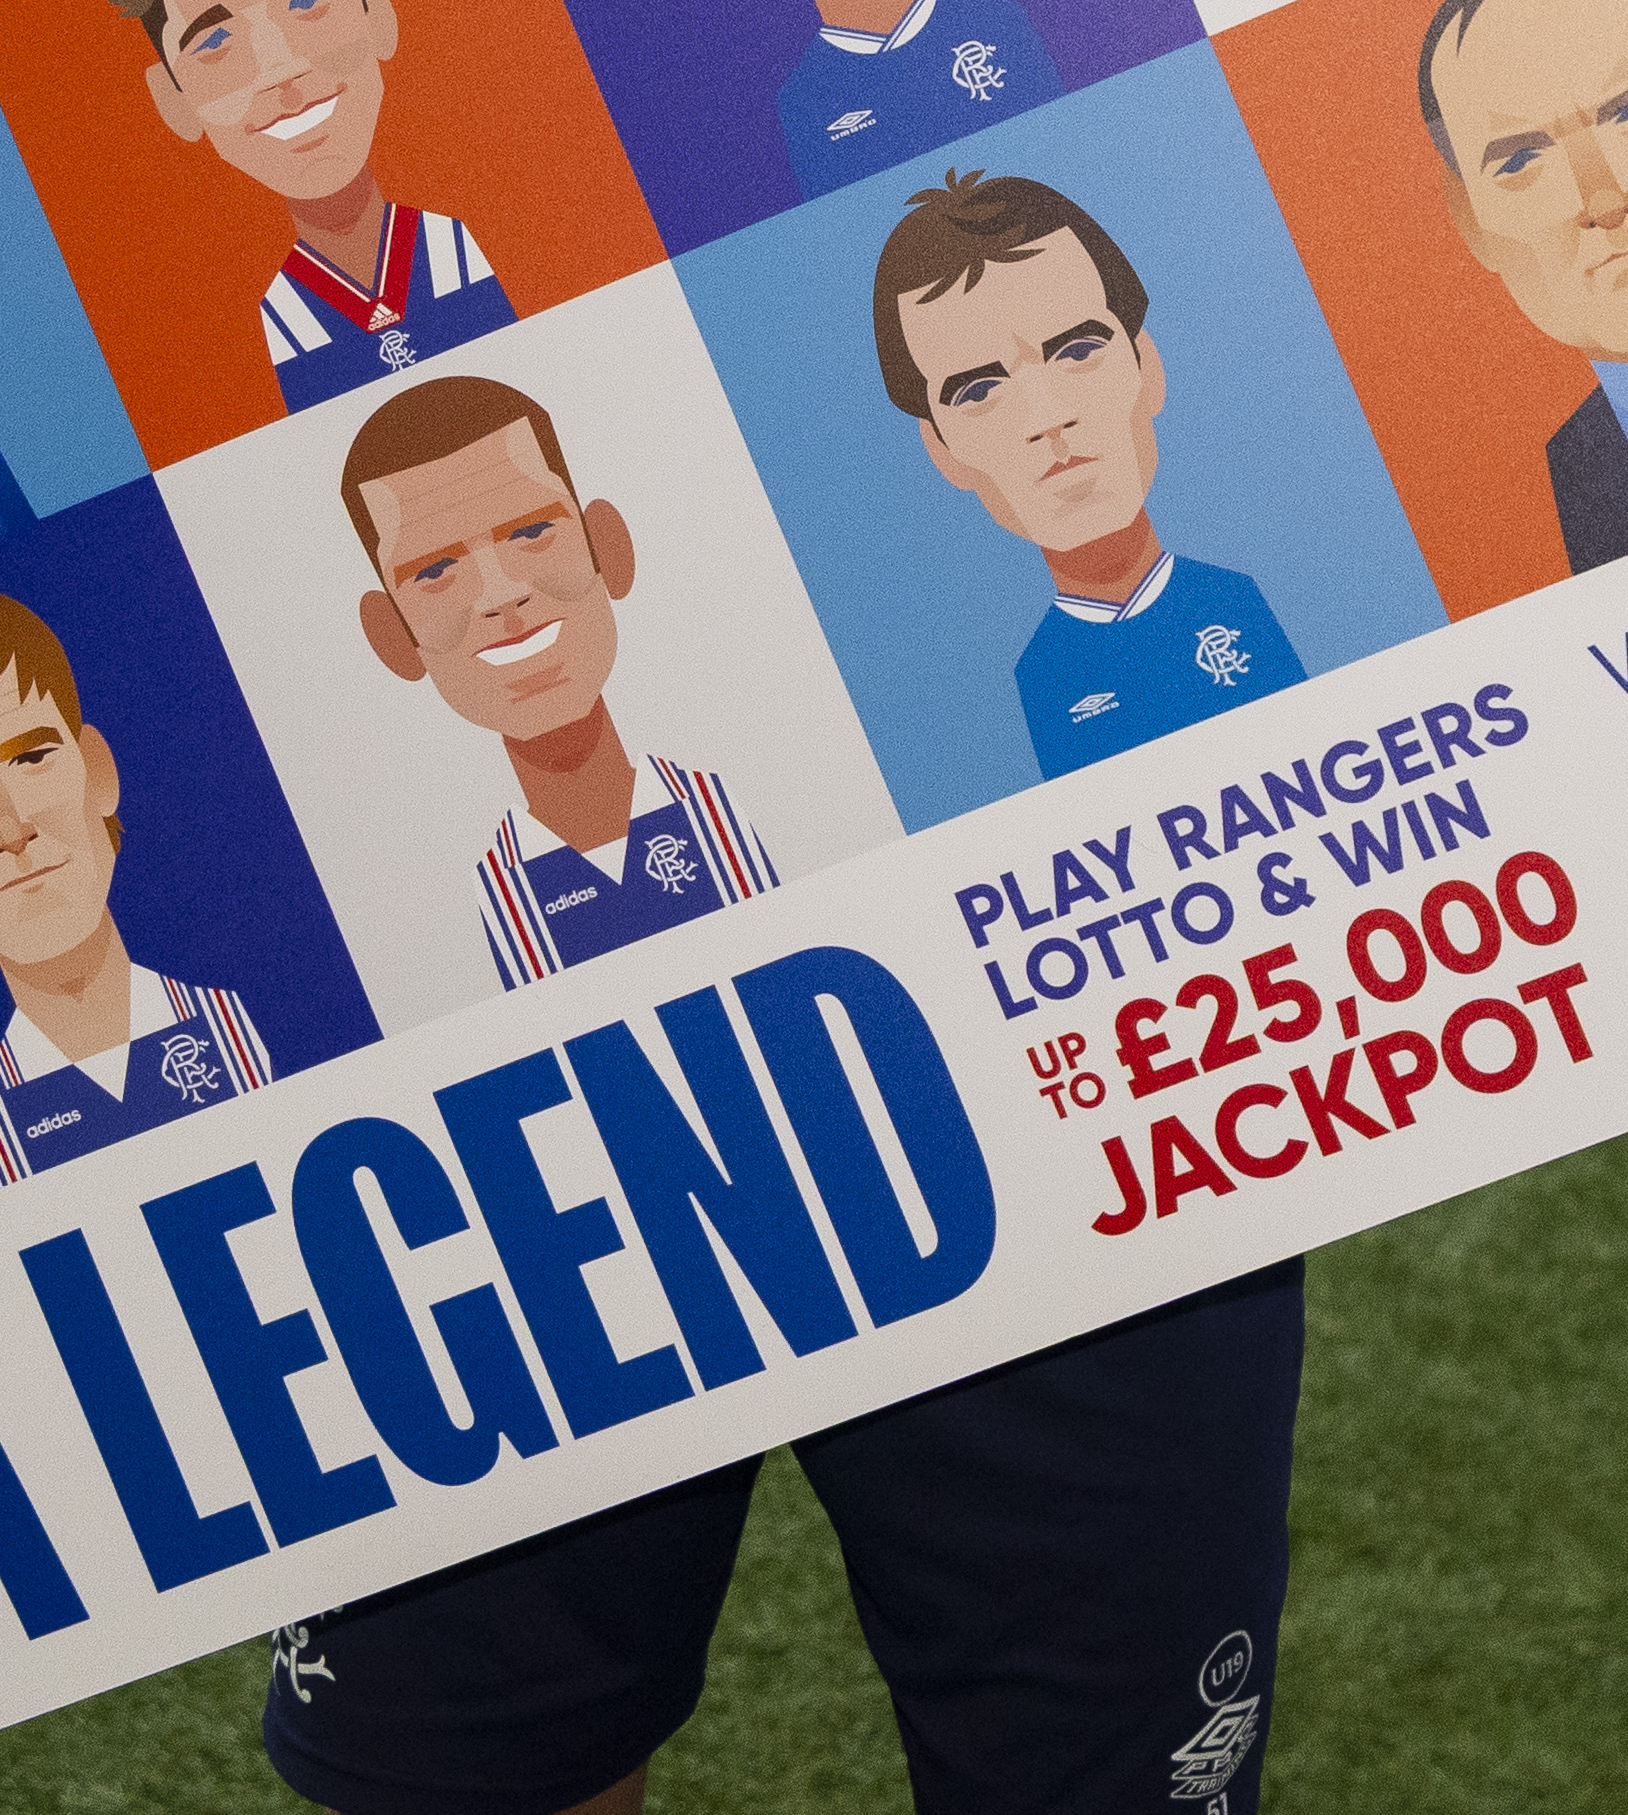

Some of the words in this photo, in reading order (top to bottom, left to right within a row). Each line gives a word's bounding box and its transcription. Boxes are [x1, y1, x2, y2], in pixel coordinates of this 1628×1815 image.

[953, 826, 1134, 949] PLAY
[1156, 683, 1529, 871] RANGERS
[544, 885, 599, 916] adidas
[984, 881, 1235, 1021] LOTTO
[1257, 851, 1317, 917] &
[1318, 779, 1491, 888] WIN
[1113, 850, 1578, 1101] £25,000
[26, 1108, 82, 1139] adidas
[1026, 1031, 1087, 1081] UP
[1039, 1070, 1107, 1120] TO
[1090, 962, 1594, 1237] JACKPOT
[17, 944, 999, 1595] LEGEND
[1210, 1650, 1244, 1686] U19
